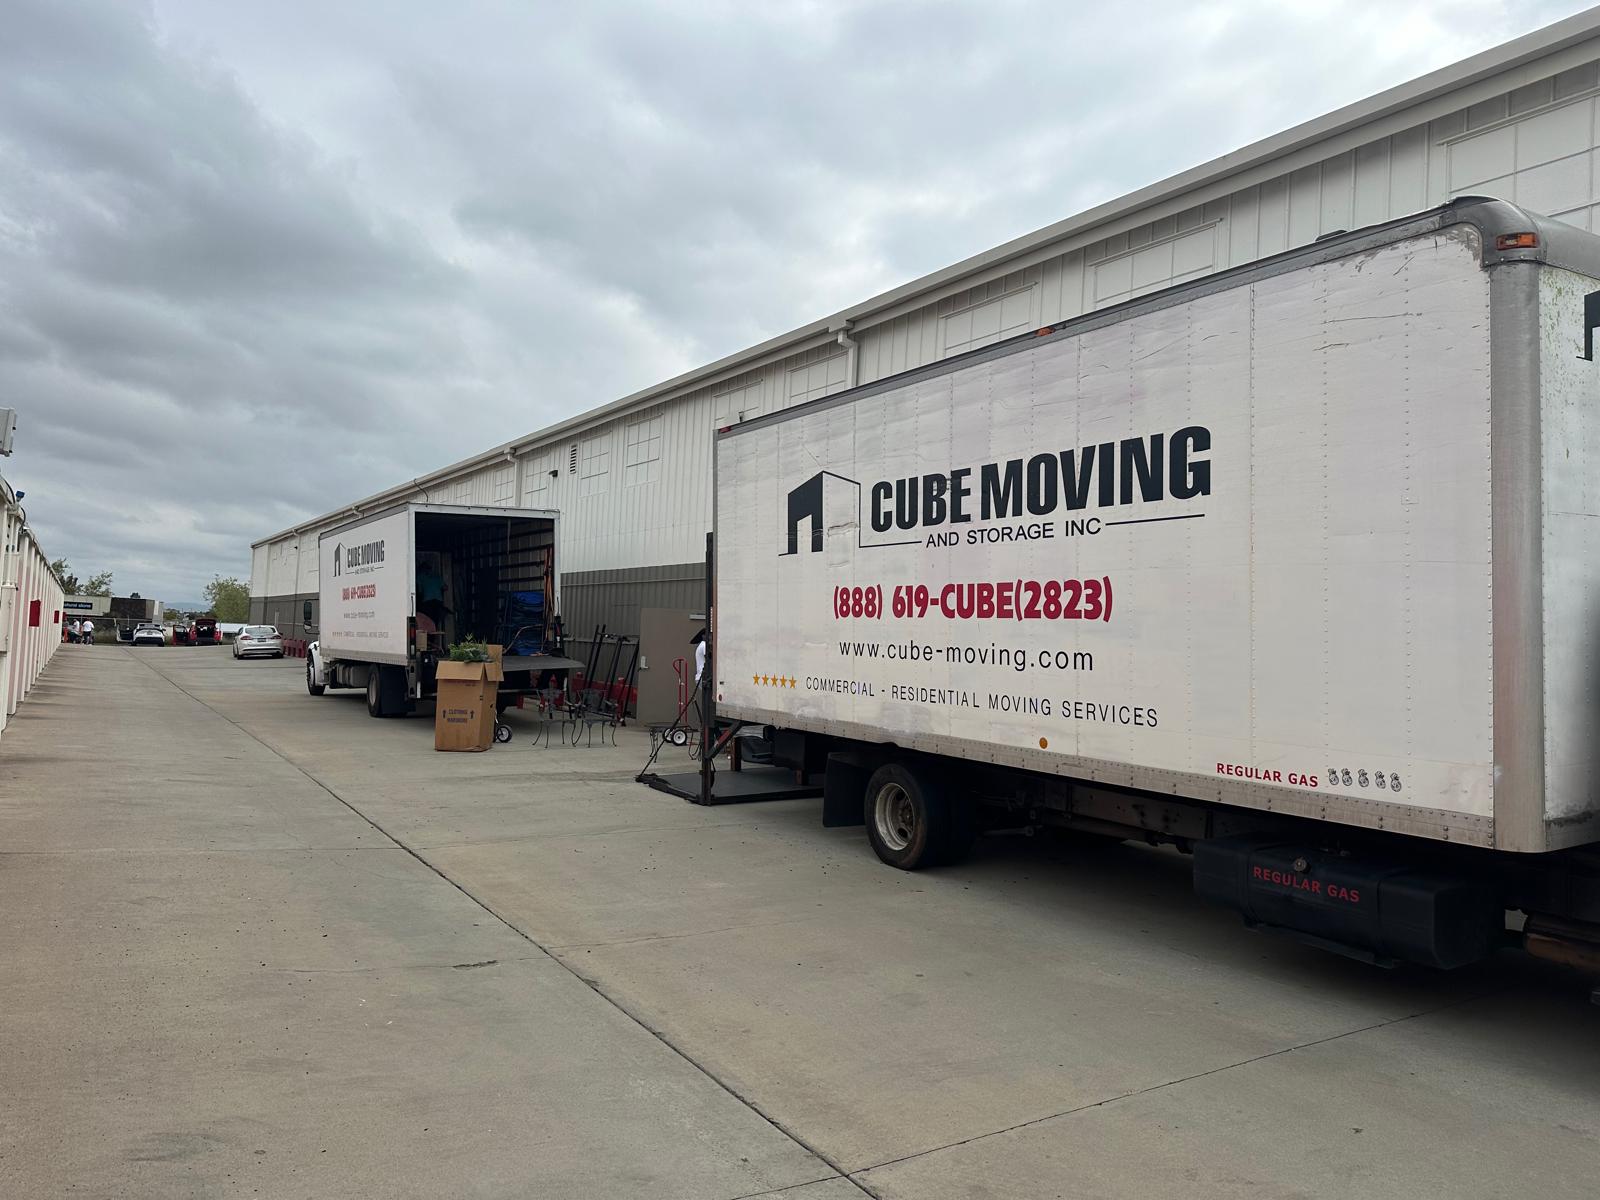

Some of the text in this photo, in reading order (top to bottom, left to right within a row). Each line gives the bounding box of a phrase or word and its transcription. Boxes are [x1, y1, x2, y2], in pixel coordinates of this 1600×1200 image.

[871, 426, 1211, 533] CUBE MOVING
[926, 518, 1102, 548] AND STORAGE INC
[833, 575, 1113, 623] (888) 619-CUBE(2823)
[839, 639, 1094, 671] www.cube-moving.com
[806, 677, 875, 697] COMMERCIAL
[892, 685, 980, 709] RESIDENTIAL
[988, 694, 1052, 717] MOVING
[1061, 700, 1158, 728] SERVICES
[1216, 763, 1319, 788] REGULAR GAS
[1253, 866, 1361, 903] REGULAR GAS
